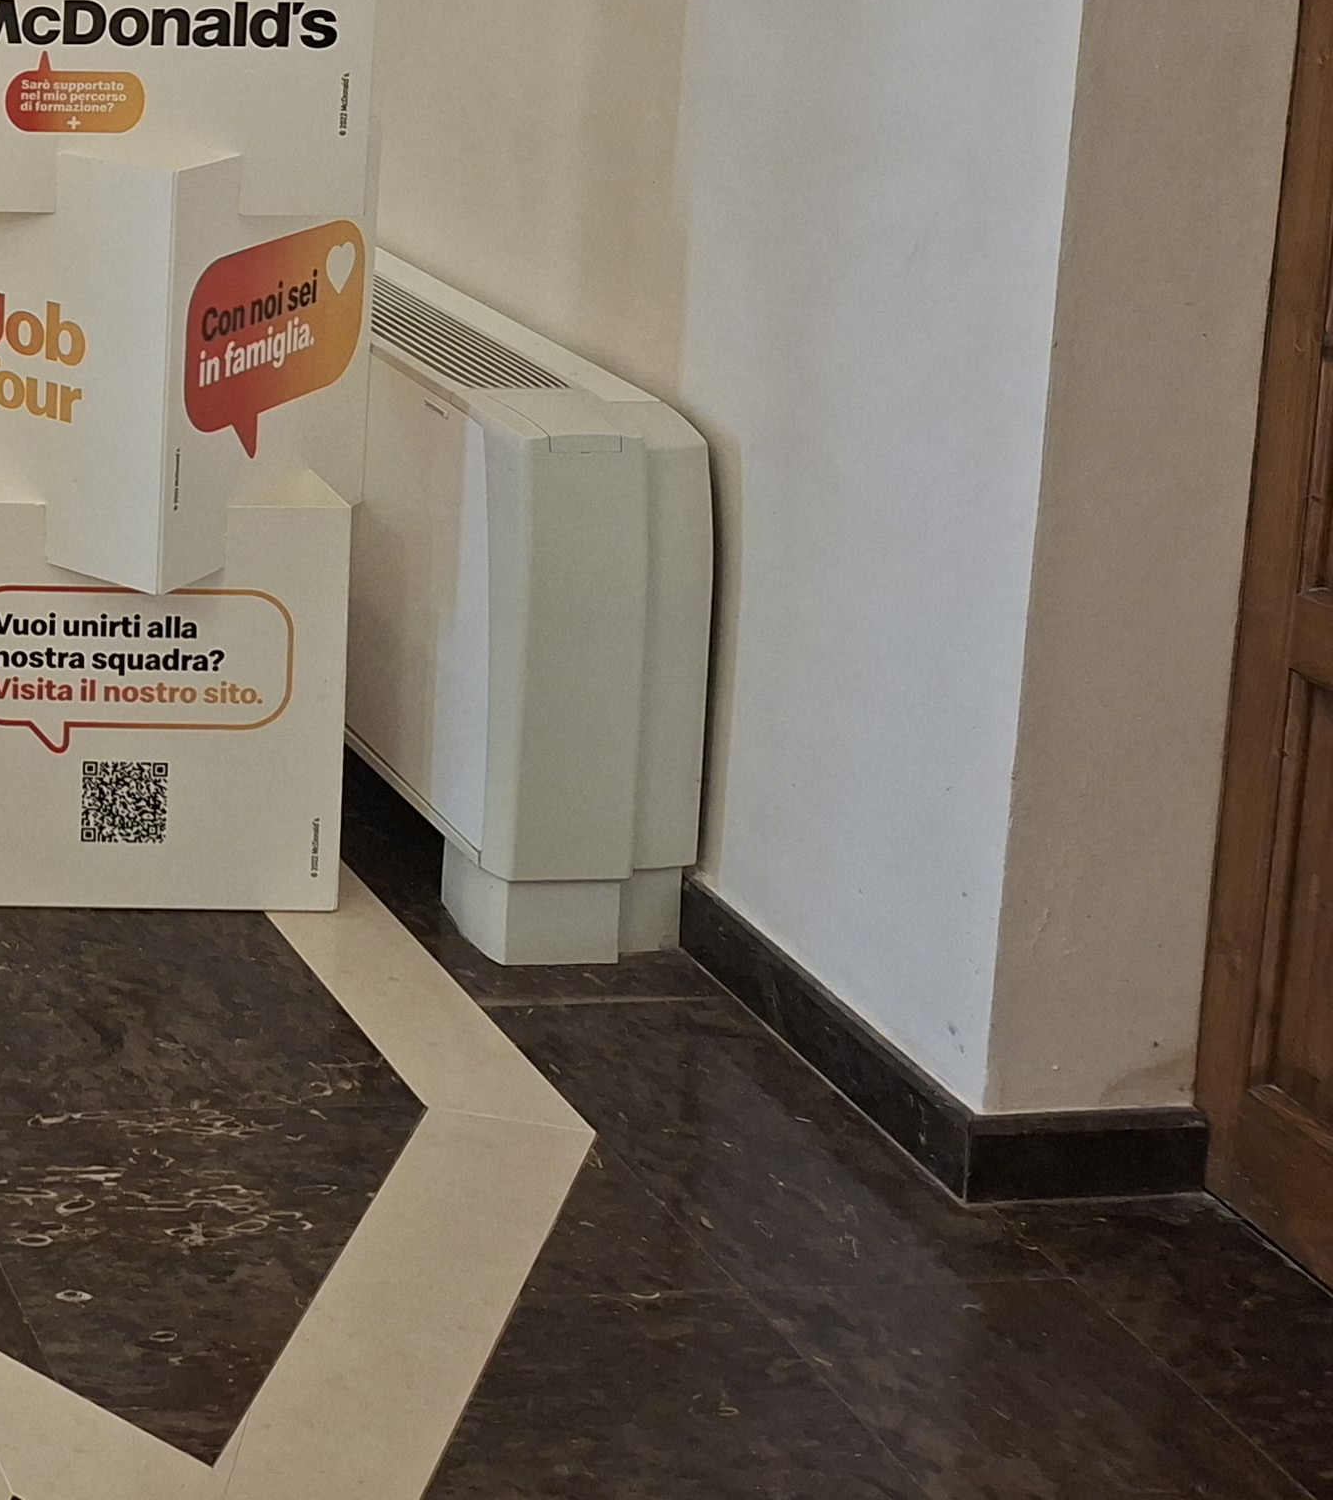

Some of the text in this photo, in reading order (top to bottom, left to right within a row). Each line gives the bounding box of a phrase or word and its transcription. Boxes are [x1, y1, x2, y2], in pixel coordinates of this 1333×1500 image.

[21, 78, 124, 94] Sarò supportato
[21, 91, 127, 106] nel mio percorso
[20, 102, 115, 114] di formazione?
[202, 269, 318, 342] Con noi sei
[198, 319, 316, 388] in famiglia.
[62, 615, 142, 638] unirti
[146, 616, 198, 640] alla
[91, 648, 226, 679] squadra?
[79, 679, 97, 703] il
[103, 683, 198, 704] nostro
[203, 681, 264, 706] sito.
